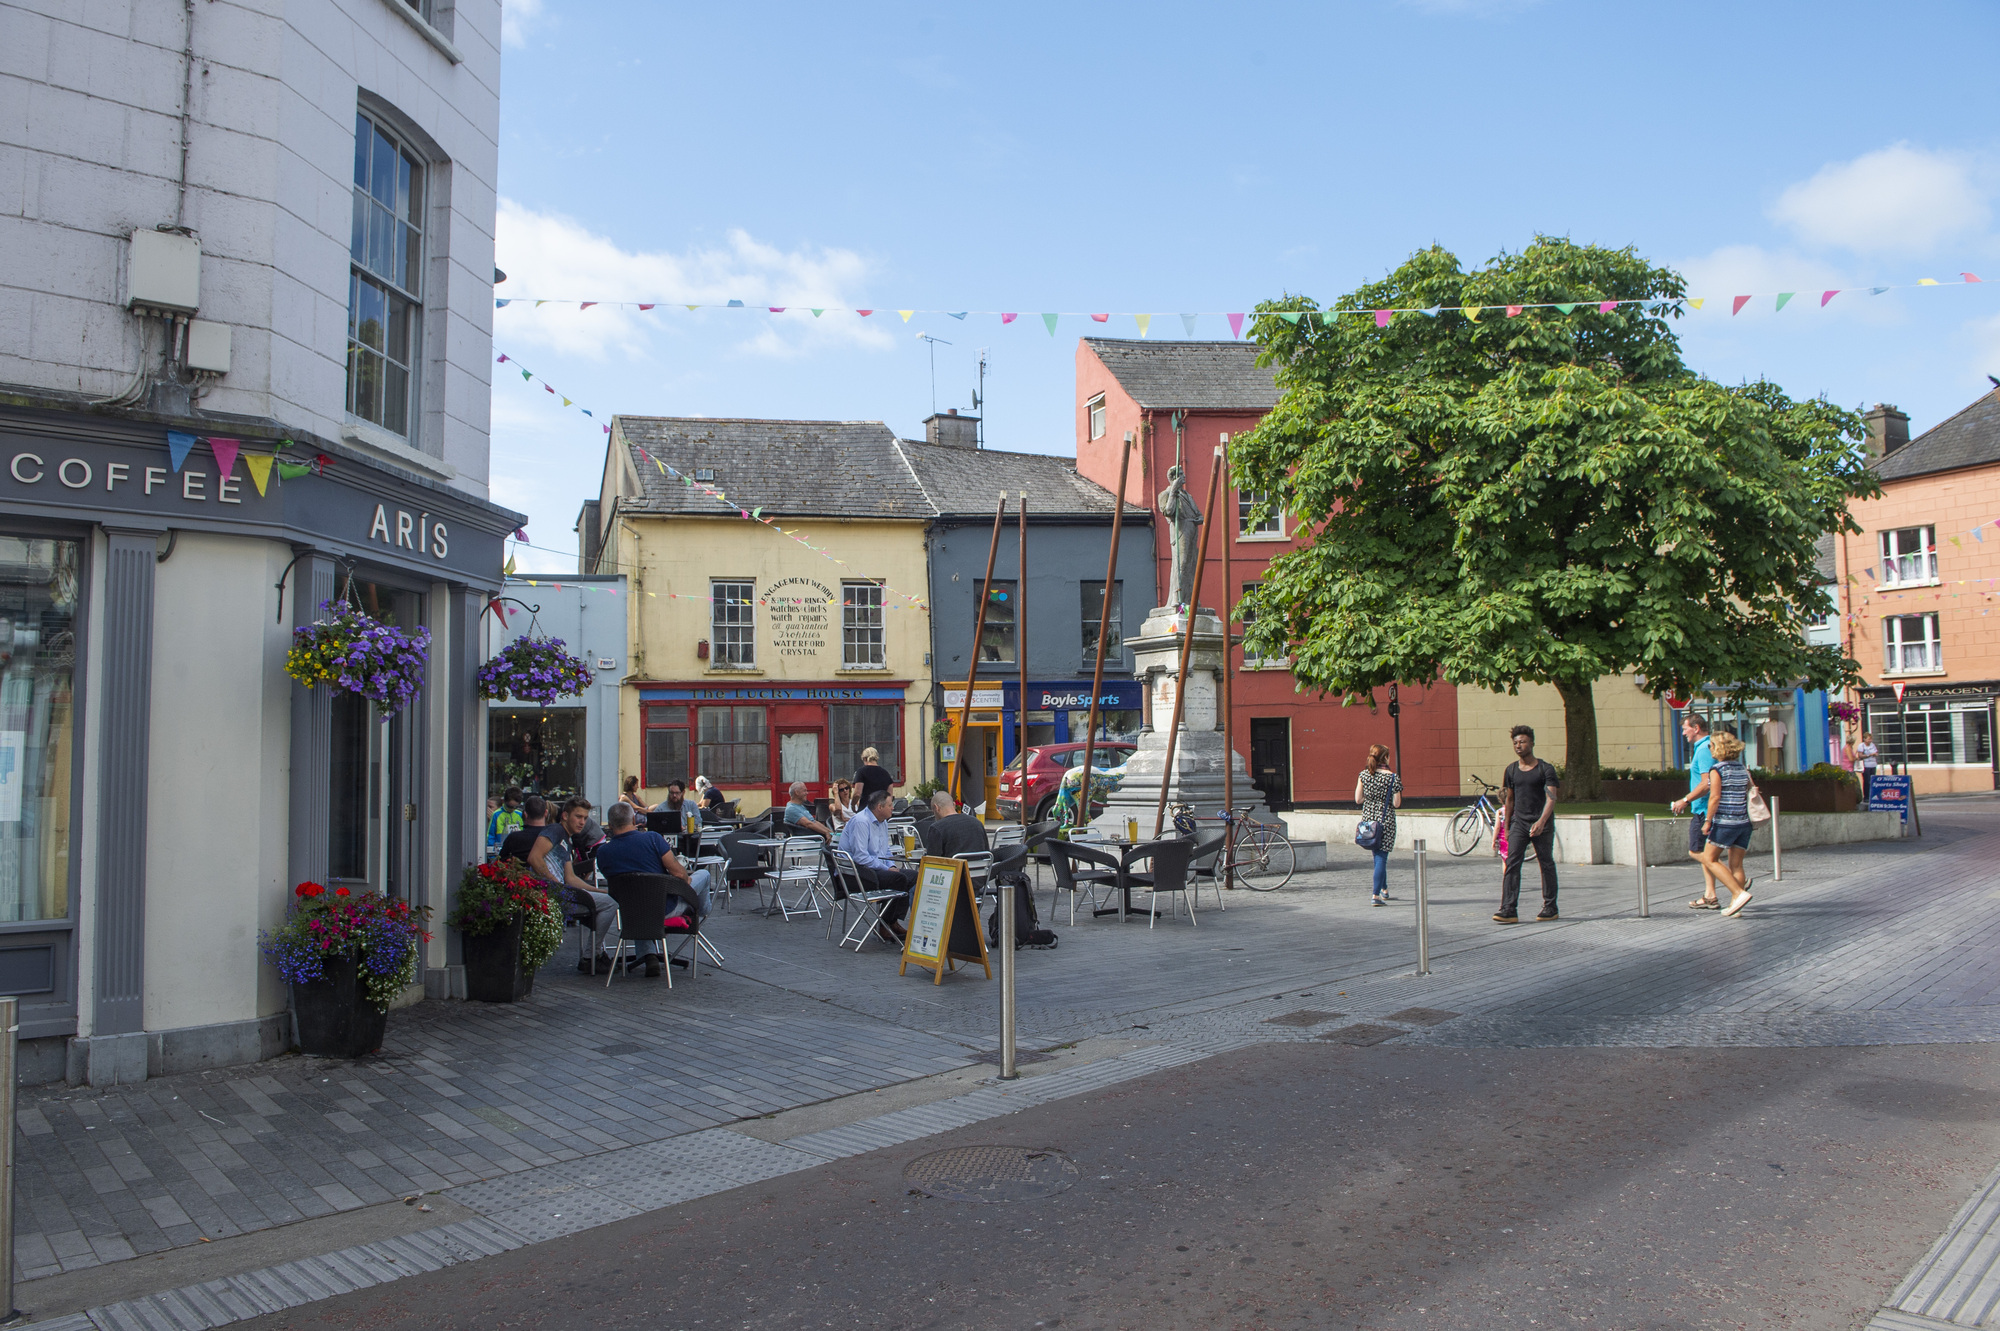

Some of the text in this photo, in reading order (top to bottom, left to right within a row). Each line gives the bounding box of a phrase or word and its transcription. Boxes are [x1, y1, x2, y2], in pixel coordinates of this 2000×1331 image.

[10, 453, 242, 504] COFFEE
[368, 503, 449, 559] ARÍS
[761, 577, 836, 602] ENGAGEMENT WEDDIN
[689, 689, 725, 699] The
[1902, 687, 1991, 697] NEWSAGENT
[1041, 694, 1120, 708] BoyleSprts
[1881, 791, 1900, 799] SALE
